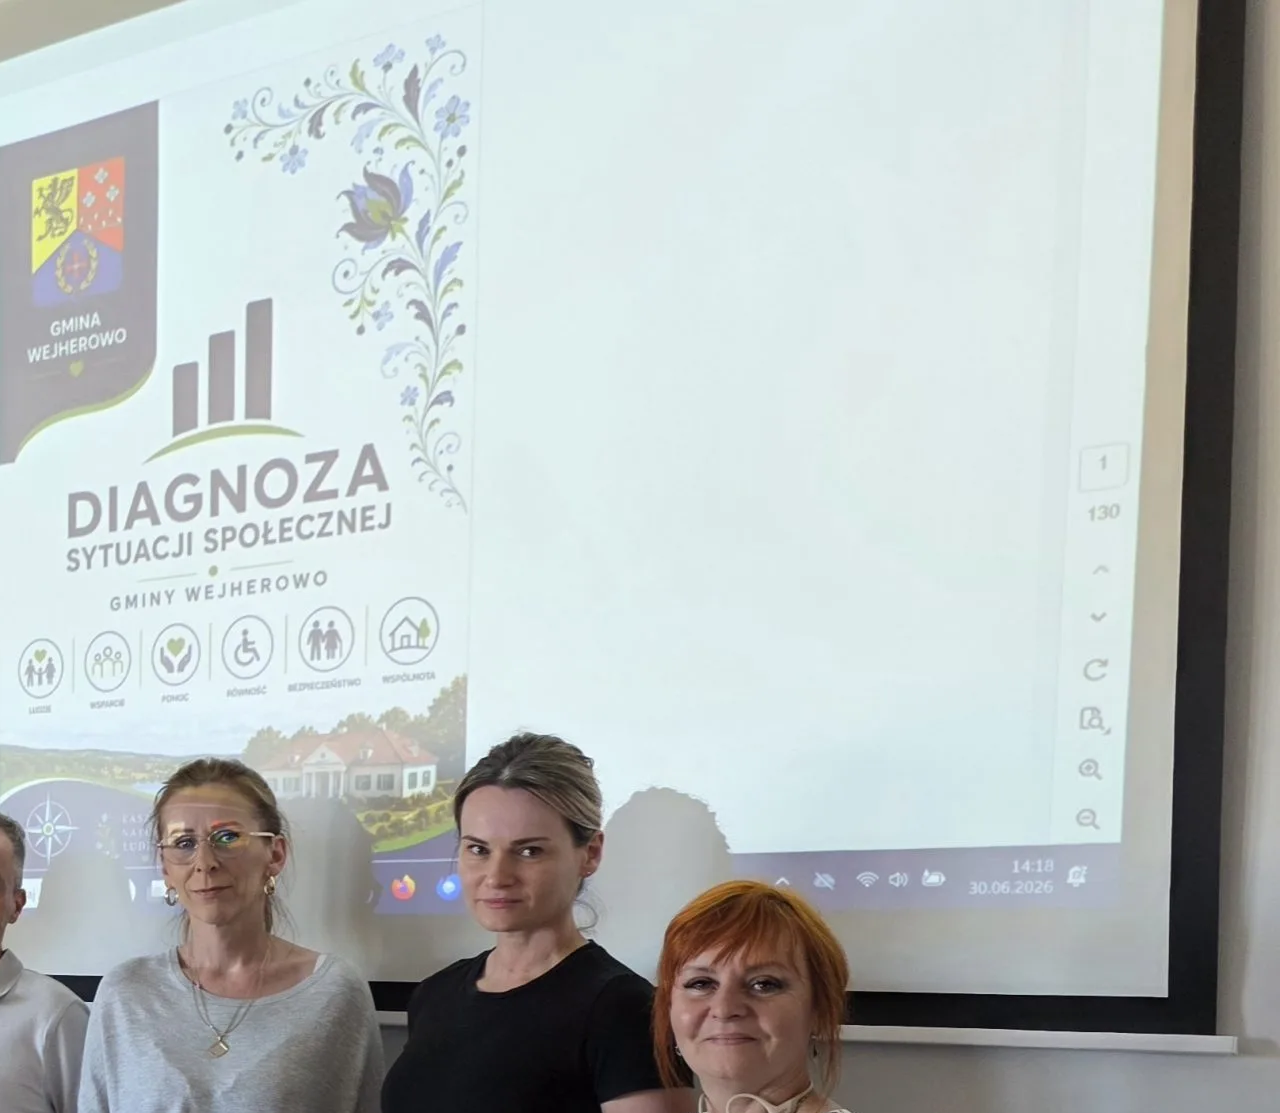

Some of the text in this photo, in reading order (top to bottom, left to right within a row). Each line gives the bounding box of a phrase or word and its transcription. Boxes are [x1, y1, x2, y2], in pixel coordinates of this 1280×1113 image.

[50, 311, 101, 336] GMINA
[27, 327, 127, 363] WEJHEROWO
[1098, 454, 1108, 471] 1
[67, 443, 390, 539] DIAGNOZA
[1087, 503, 1121, 522] 130
[66, 502, 393, 572] SYTUACJI SPOŁECZNEJ
[109, 570, 328, 612] GMINY WEJHEROWO
[287, 678, 362, 692] BEZPIECZEŃSTWO
[382, 671, 436, 684] WSPÓLNOTA
[226, 685, 267, 698] RÓWNOŚĆ
[1012, 859, 1054, 873] 14:18
[968, 880, 1055, 895] 30.06.2026
